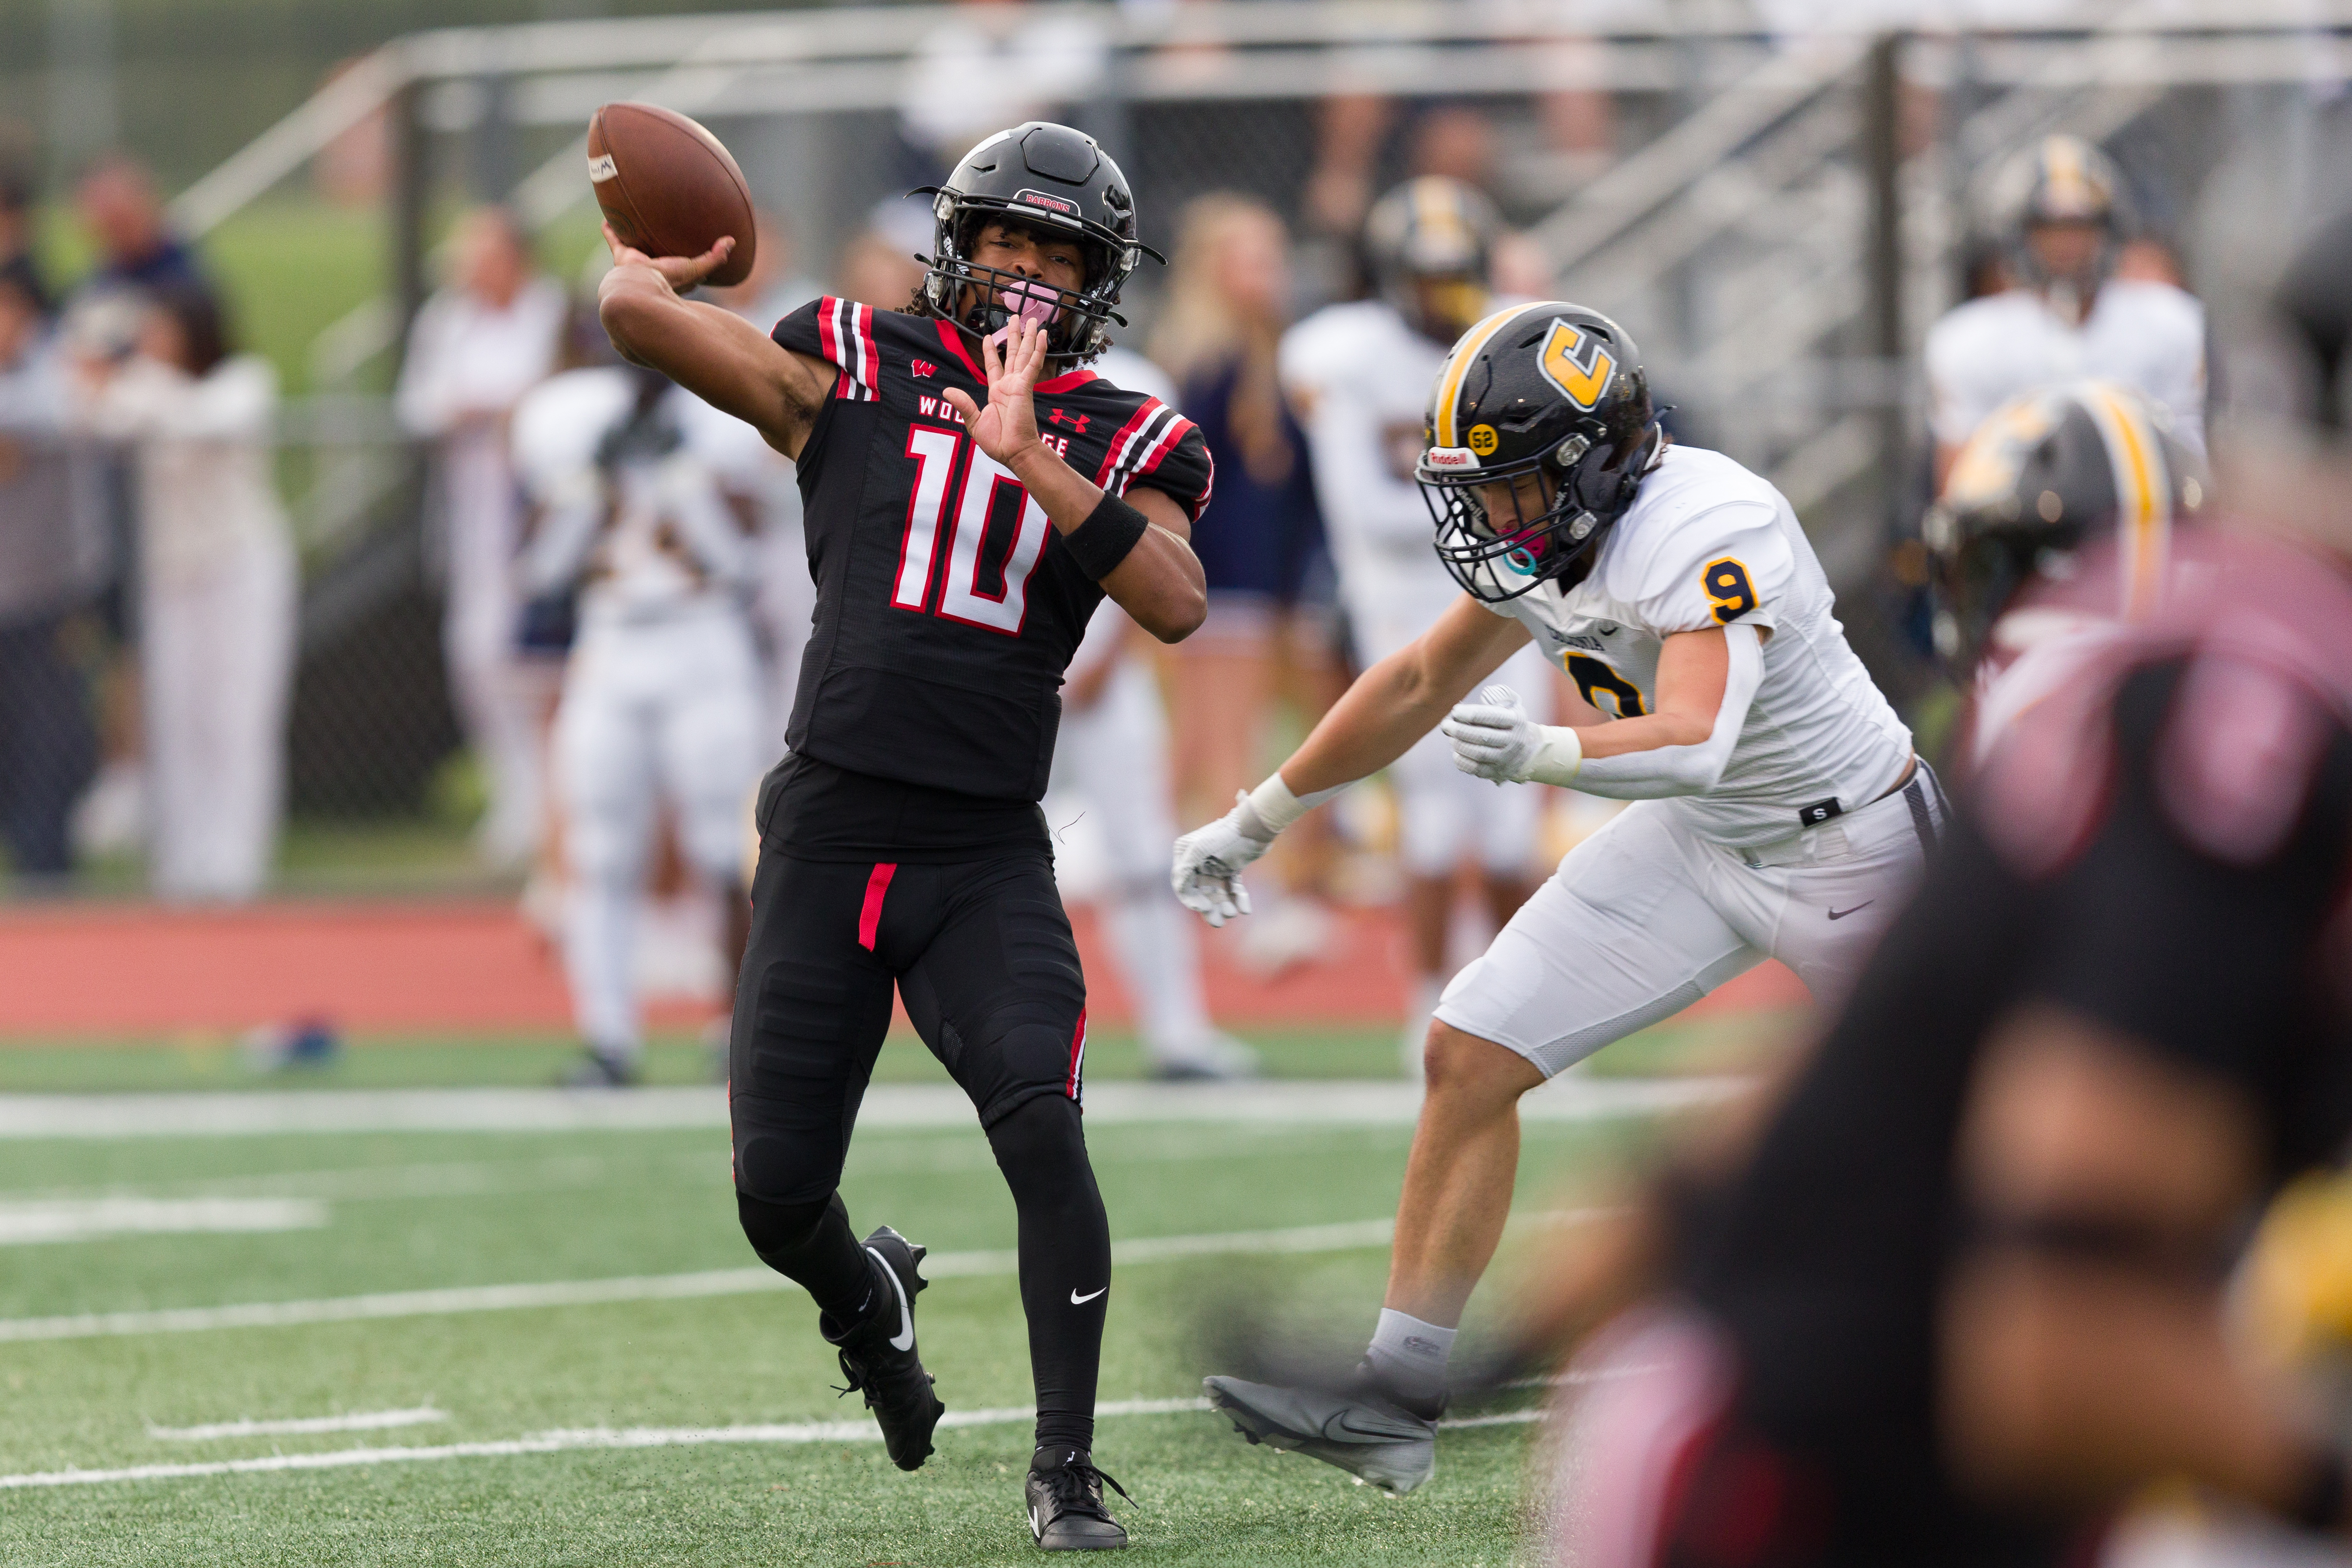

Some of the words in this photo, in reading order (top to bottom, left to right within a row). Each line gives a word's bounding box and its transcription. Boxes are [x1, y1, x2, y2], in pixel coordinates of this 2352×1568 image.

[1026, 194, 1070, 213] BARRONS
[911, 359, 938, 378] W
[1537, 317, 1617, 412] C
[1473, 431, 1494, 448] 52
[890, 423, 1051, 638] 10
[1700, 556, 1760, 626] 9
[1813, 808, 1827, 820] S
